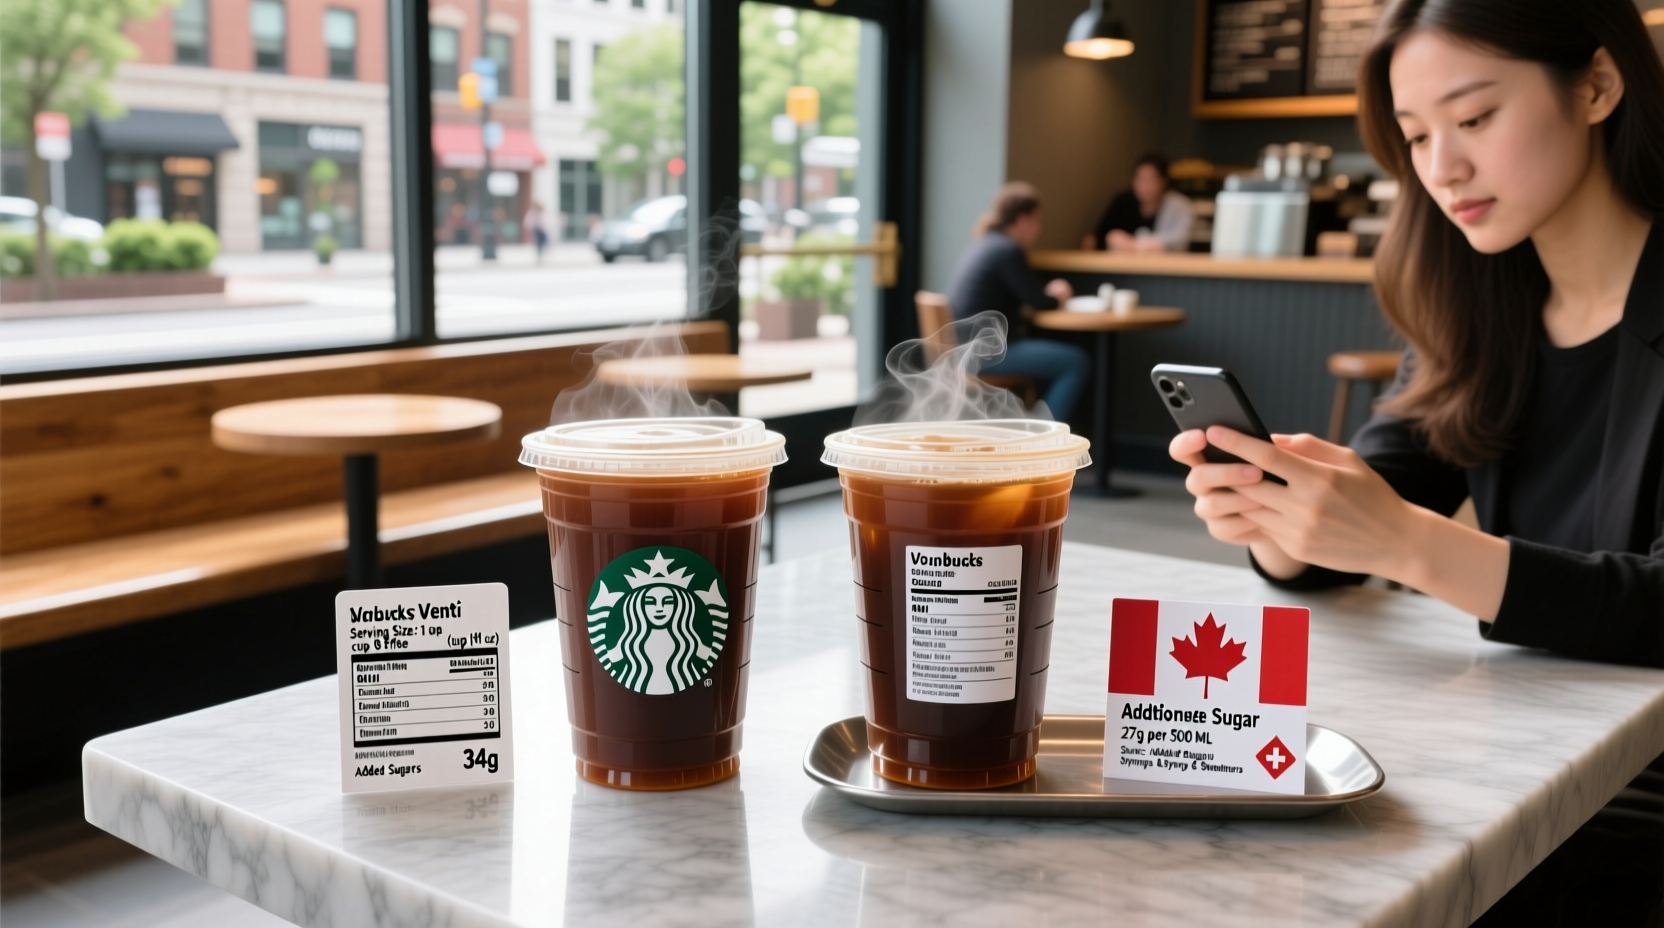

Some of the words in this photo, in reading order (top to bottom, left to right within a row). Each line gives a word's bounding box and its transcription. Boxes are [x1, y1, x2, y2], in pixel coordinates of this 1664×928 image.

[418, 600, 462, 620] Venti
[1212, 707, 1261, 731] Sugar
[1120, 726, 1144, 744] 27g
[1147, 729, 1167, 744] per
[1169, 729, 1193, 743] 500
[1195, 731, 1213, 745] ML
[463, 748, 499, 774] 34g
